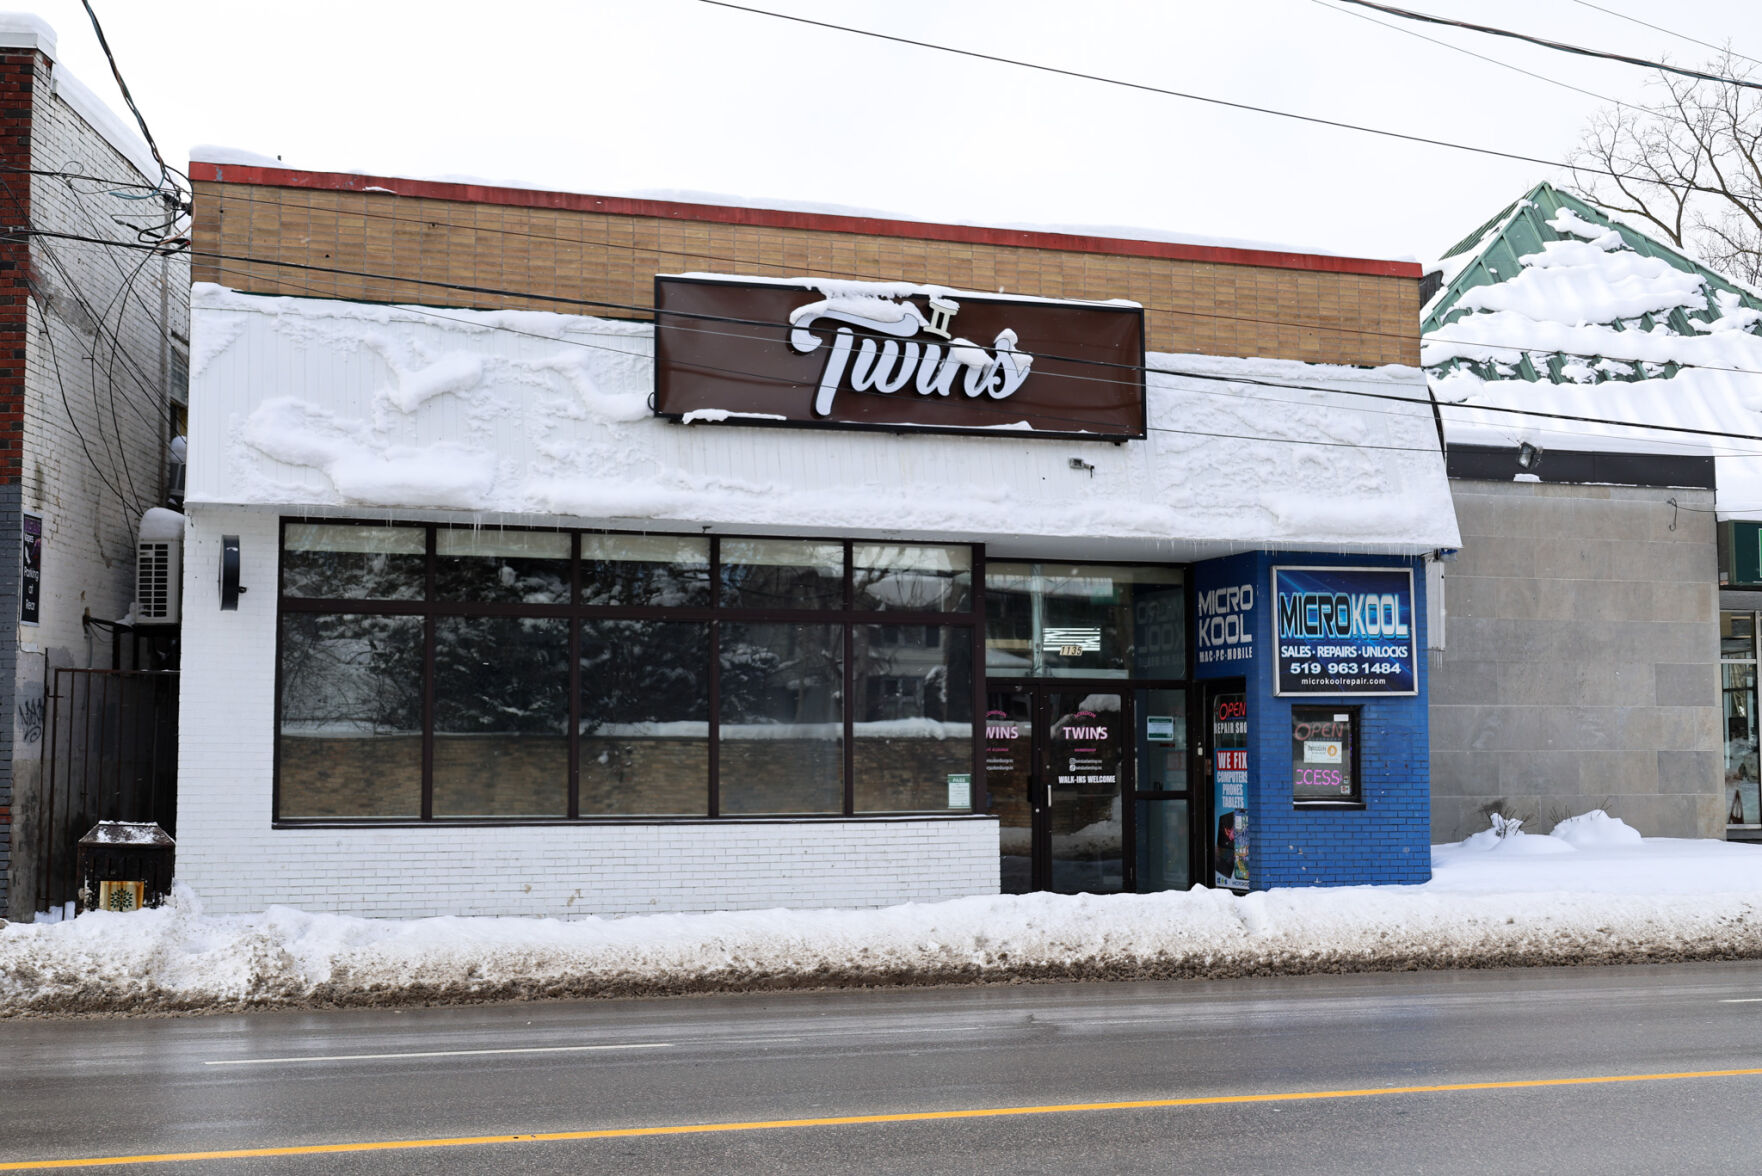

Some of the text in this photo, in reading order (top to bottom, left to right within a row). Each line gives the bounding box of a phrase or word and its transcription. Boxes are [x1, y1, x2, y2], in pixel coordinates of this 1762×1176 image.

[790, 304, 1031, 416] Twins
[1198, 584, 1254, 617] MICRO
[1279, 592, 1409, 639] MICROKOOL
[1198, 613, 1253, 648] KOOL
[1060, 646, 1083, 656] 1135
[1281, 645, 1408, 658] SALES REPAIRS UNLOCKS
[1290, 662, 1401, 674] 519 963 1484
[1301, 677, 1386, 686] microkoolrepair.com
[1219, 701, 1247, 721] OPEN
[1062, 726, 1108, 740] TWINS
[1214, 721, 1235, 734] REPAIR
[1294, 722, 1345, 741] OPEN
[1217, 752, 1248, 769] WE FIX
[1058, 775, 1116, 784] WALK-INS WELCOME
[1217, 771, 1248, 783] COMPUTERS
[1222, 784, 1244, 796] PHONES
[1222, 797, 1245, 809] TABLETS
